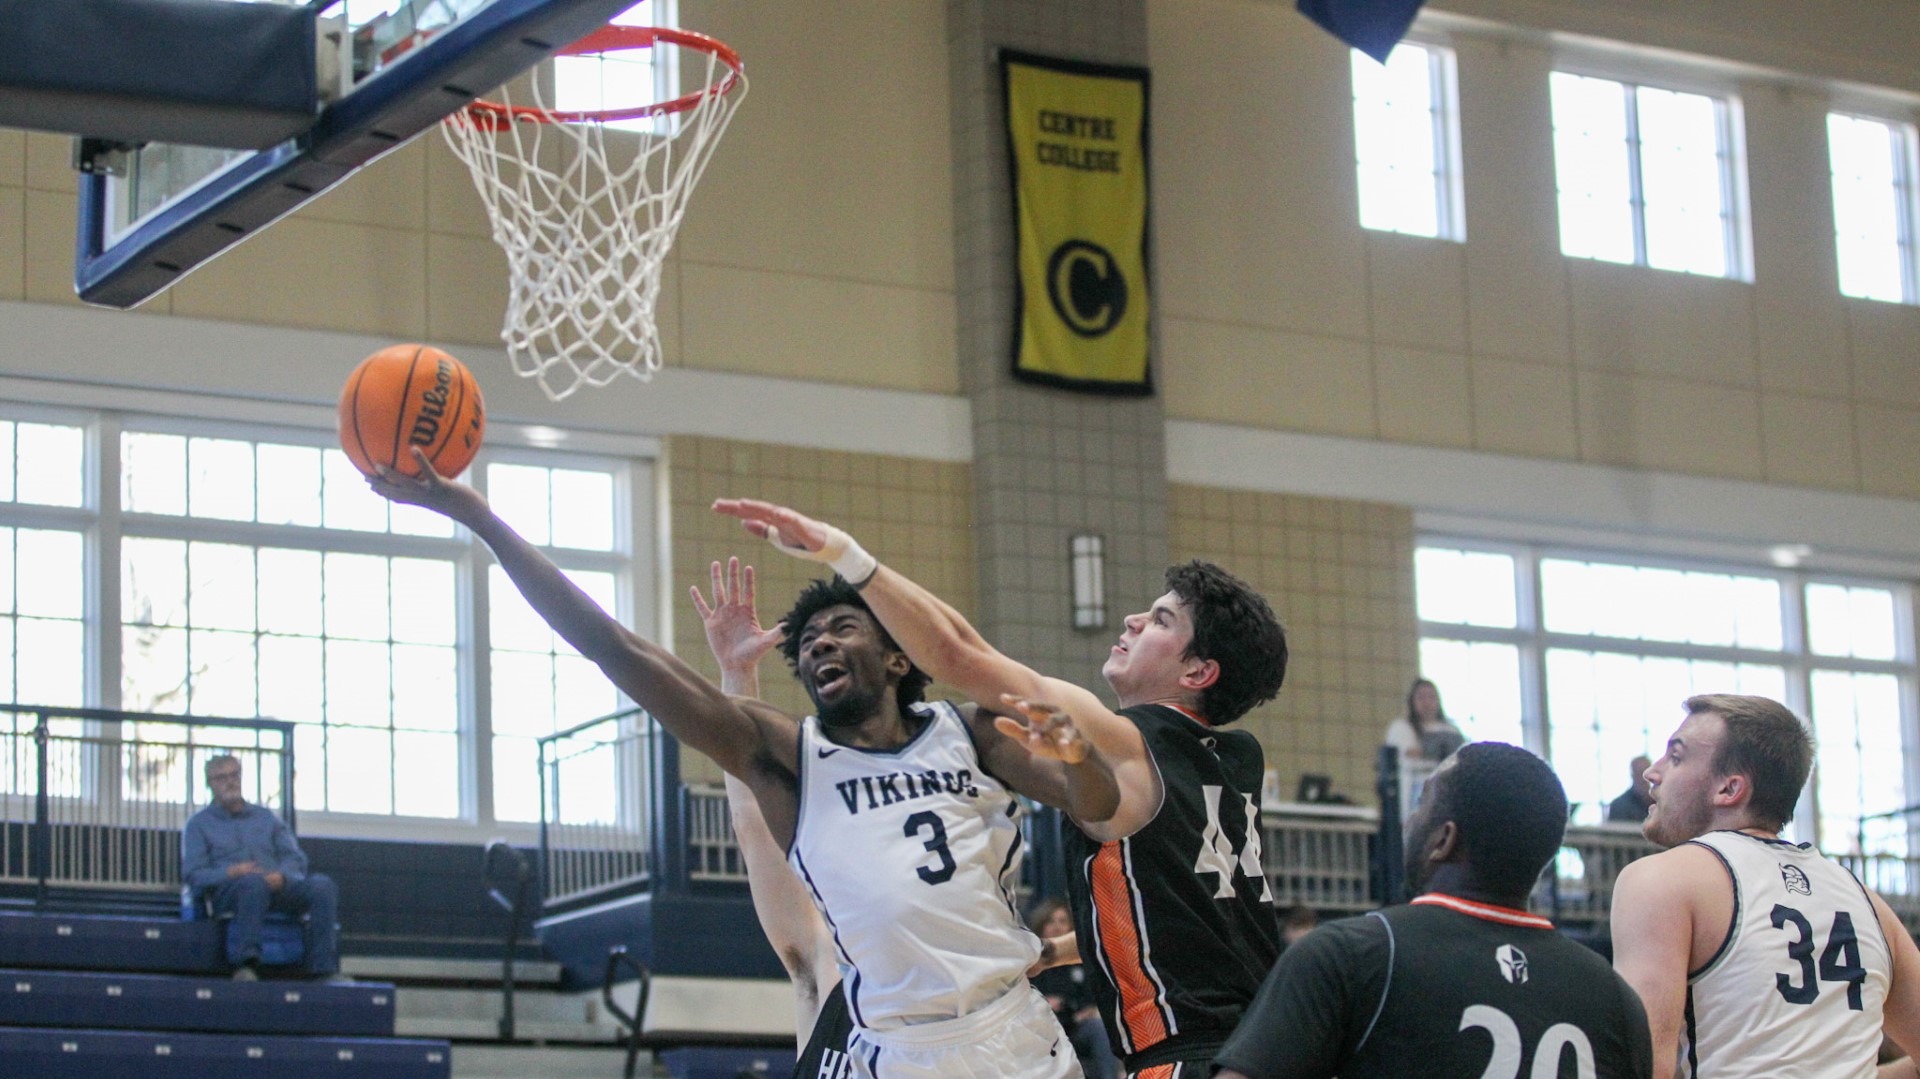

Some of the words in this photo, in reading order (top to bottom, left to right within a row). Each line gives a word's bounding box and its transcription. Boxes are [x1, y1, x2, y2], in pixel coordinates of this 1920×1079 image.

[1037, 142, 1120, 173] COLLEGE
[1038, 109, 1115, 140] CENTRE
[1050, 243, 1119, 335] C
[408, 359, 452, 446] Wilson
[903, 810, 957, 886] 3
[1194, 785, 1274, 903] 44
[1770, 903, 1868, 1011] 34
